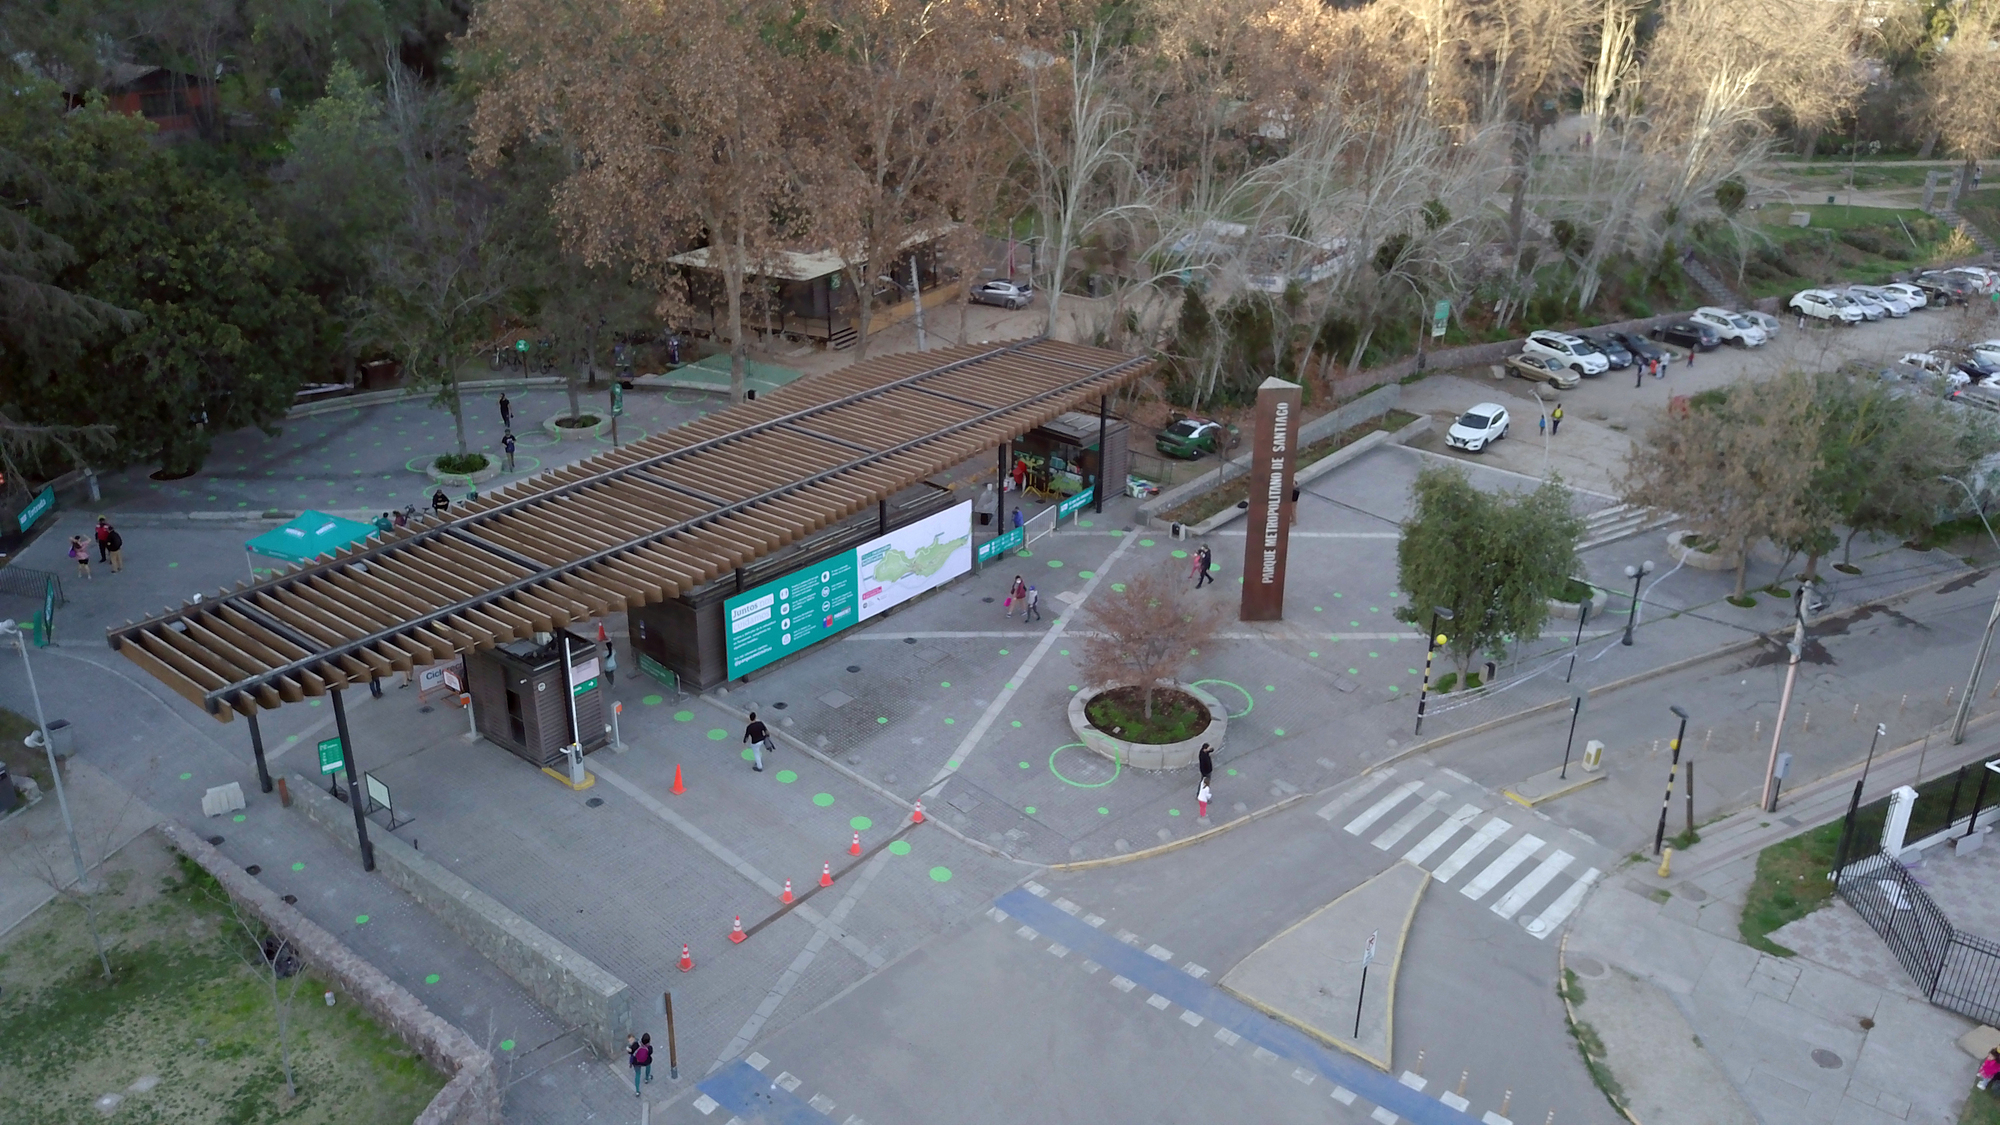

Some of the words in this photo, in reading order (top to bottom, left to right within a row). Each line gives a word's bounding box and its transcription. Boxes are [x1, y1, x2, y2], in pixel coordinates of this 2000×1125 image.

[1273, 402, 1289, 452] SANTIAGO
[1271, 456, 1284, 470] DE
[1264, 472, 1283, 547] METROPOLITANO
[1261, 549, 1277, 584] PARQUE
[733, 603, 758, 618] Juntos
